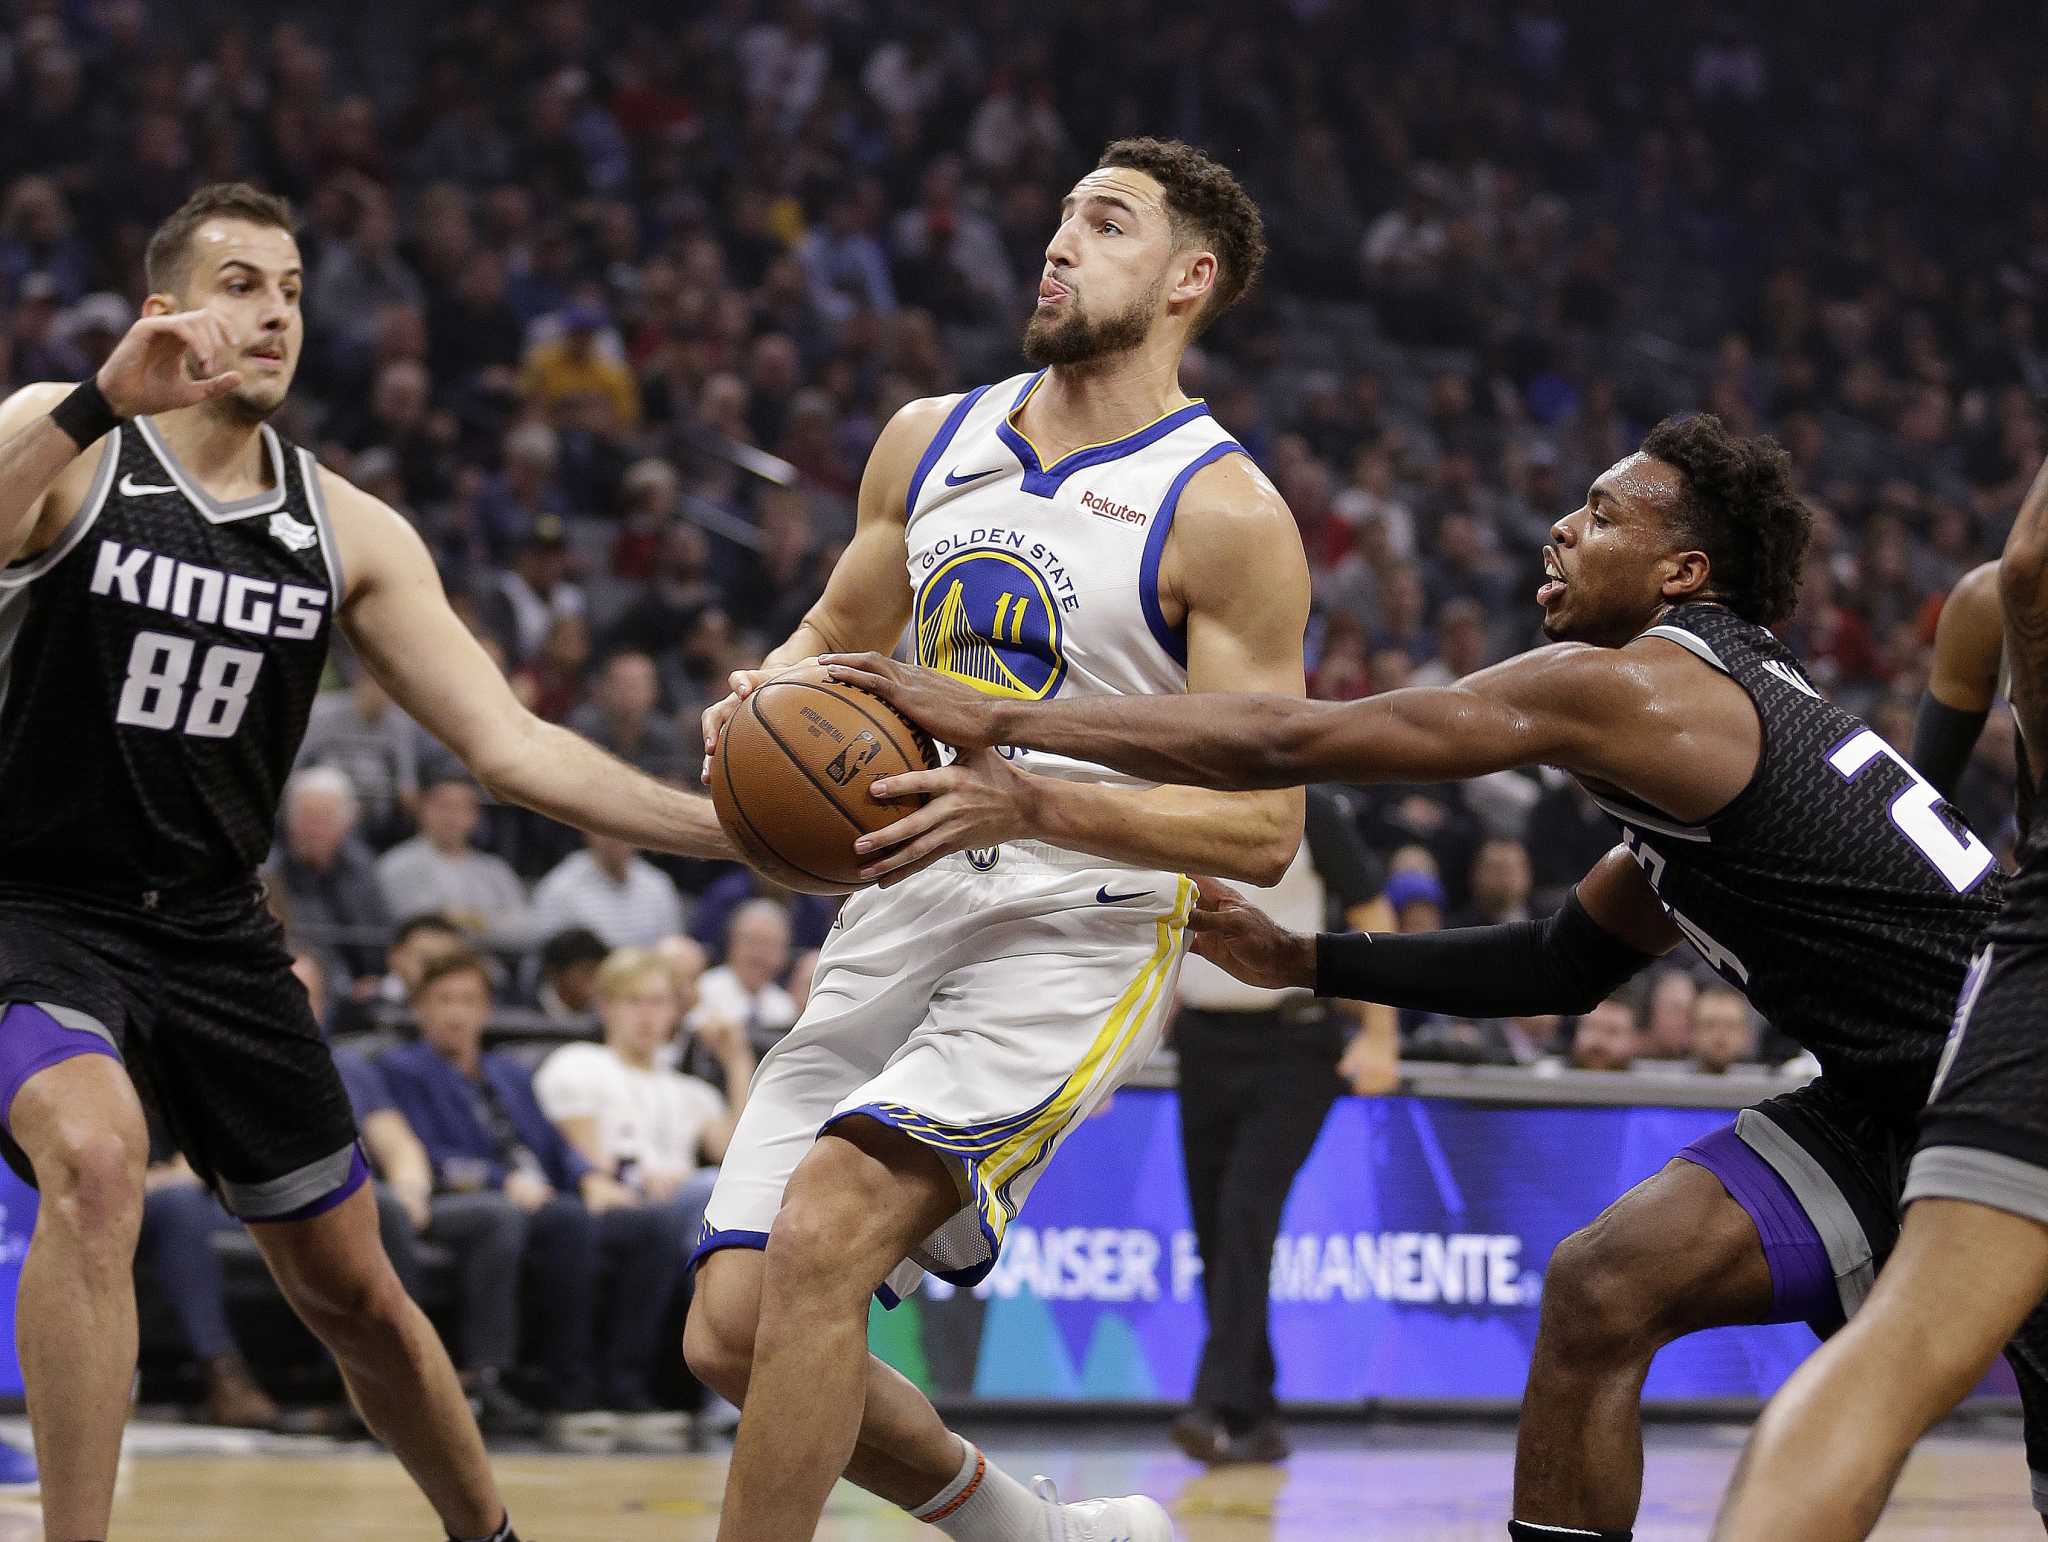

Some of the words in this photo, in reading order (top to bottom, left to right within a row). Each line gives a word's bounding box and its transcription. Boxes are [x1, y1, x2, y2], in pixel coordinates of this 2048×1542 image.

[1080, 490, 1147, 526] Rakuten
[90, 540, 328, 641] KINGS
[921, 528, 1025, 570] GOLDEN
[1030, 543, 1080, 614] STATE
[992, 592, 1029, 644] 11
[116, 631, 264, 738] 88
